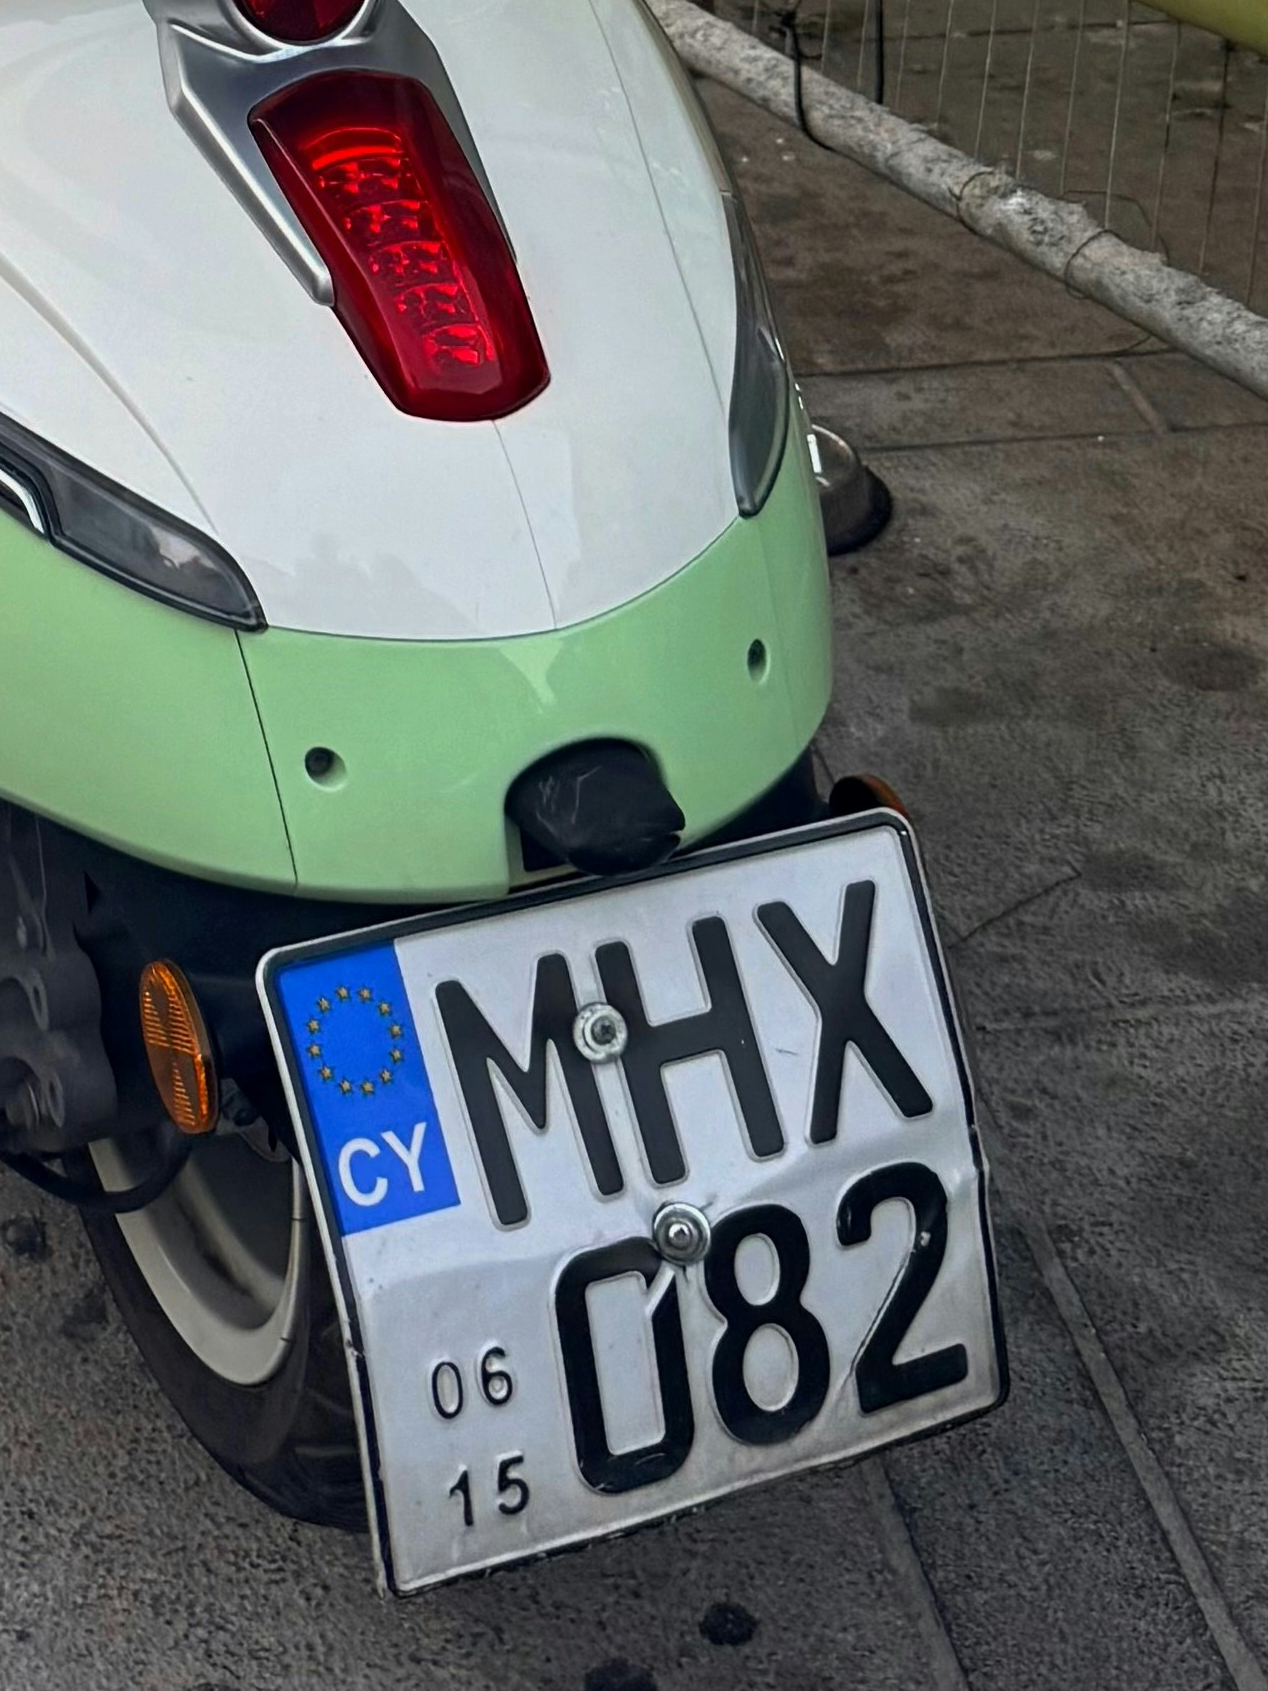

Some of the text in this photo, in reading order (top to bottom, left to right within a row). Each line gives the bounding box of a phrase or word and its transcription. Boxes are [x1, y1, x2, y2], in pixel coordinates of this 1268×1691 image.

[434, 879, 933, 1227] MHX
[337, 1121, 431, 1207] CY
[554, 1161, 969, 1495] 082
[430, 1345, 515, 1421] 06
[448, 1454, 531, 1527] 15
